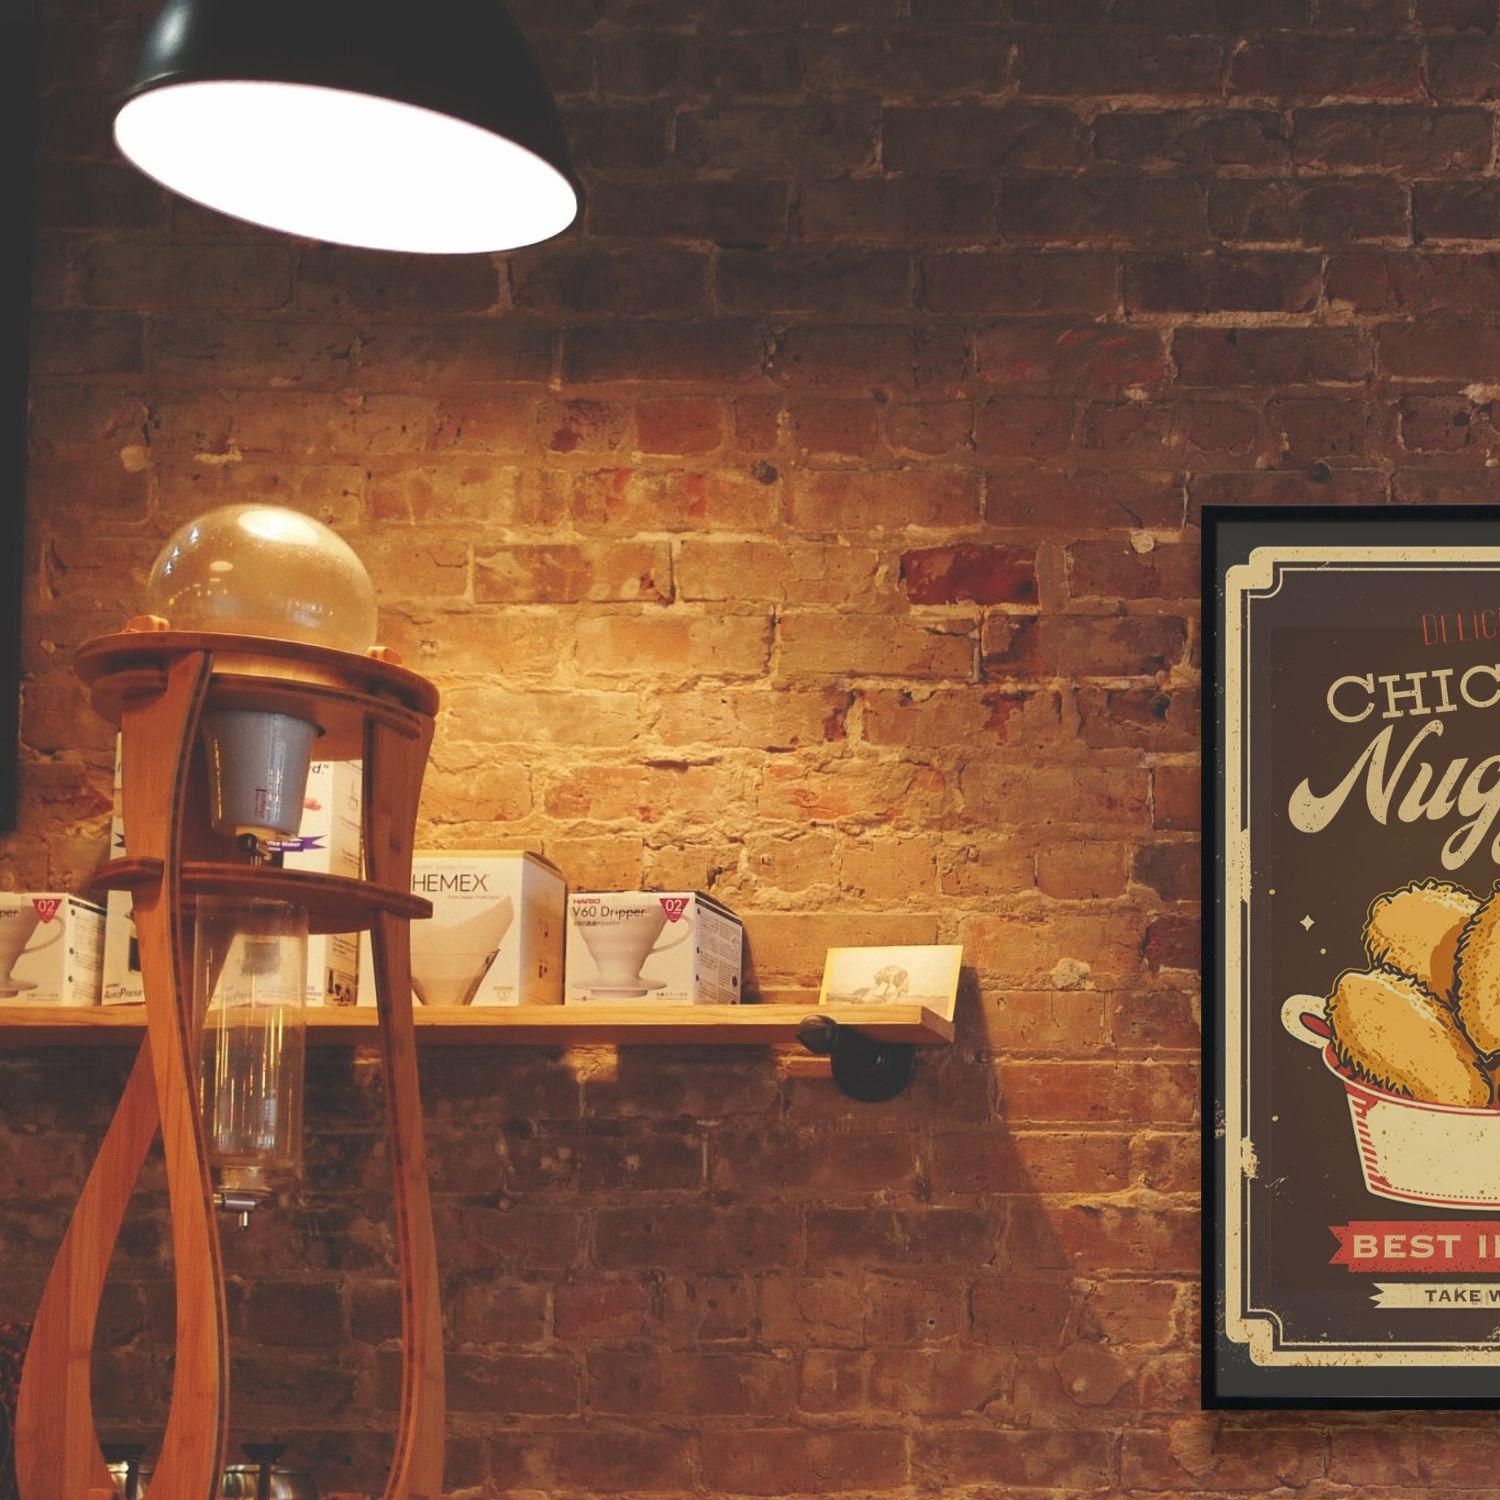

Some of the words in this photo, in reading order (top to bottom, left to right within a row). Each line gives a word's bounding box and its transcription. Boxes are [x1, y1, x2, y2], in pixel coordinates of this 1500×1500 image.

[412, 873, 488, 892] HEMEX
[38, 901, 55, 912] 02
[665, 900, 683, 912] 02
[572, 907, 597, 917] V60
[601, 906, 646, 920] Dripper
[1353, 1234, 1462, 1259] BEST
[1425, 1290, 1482, 1303] TAKE
